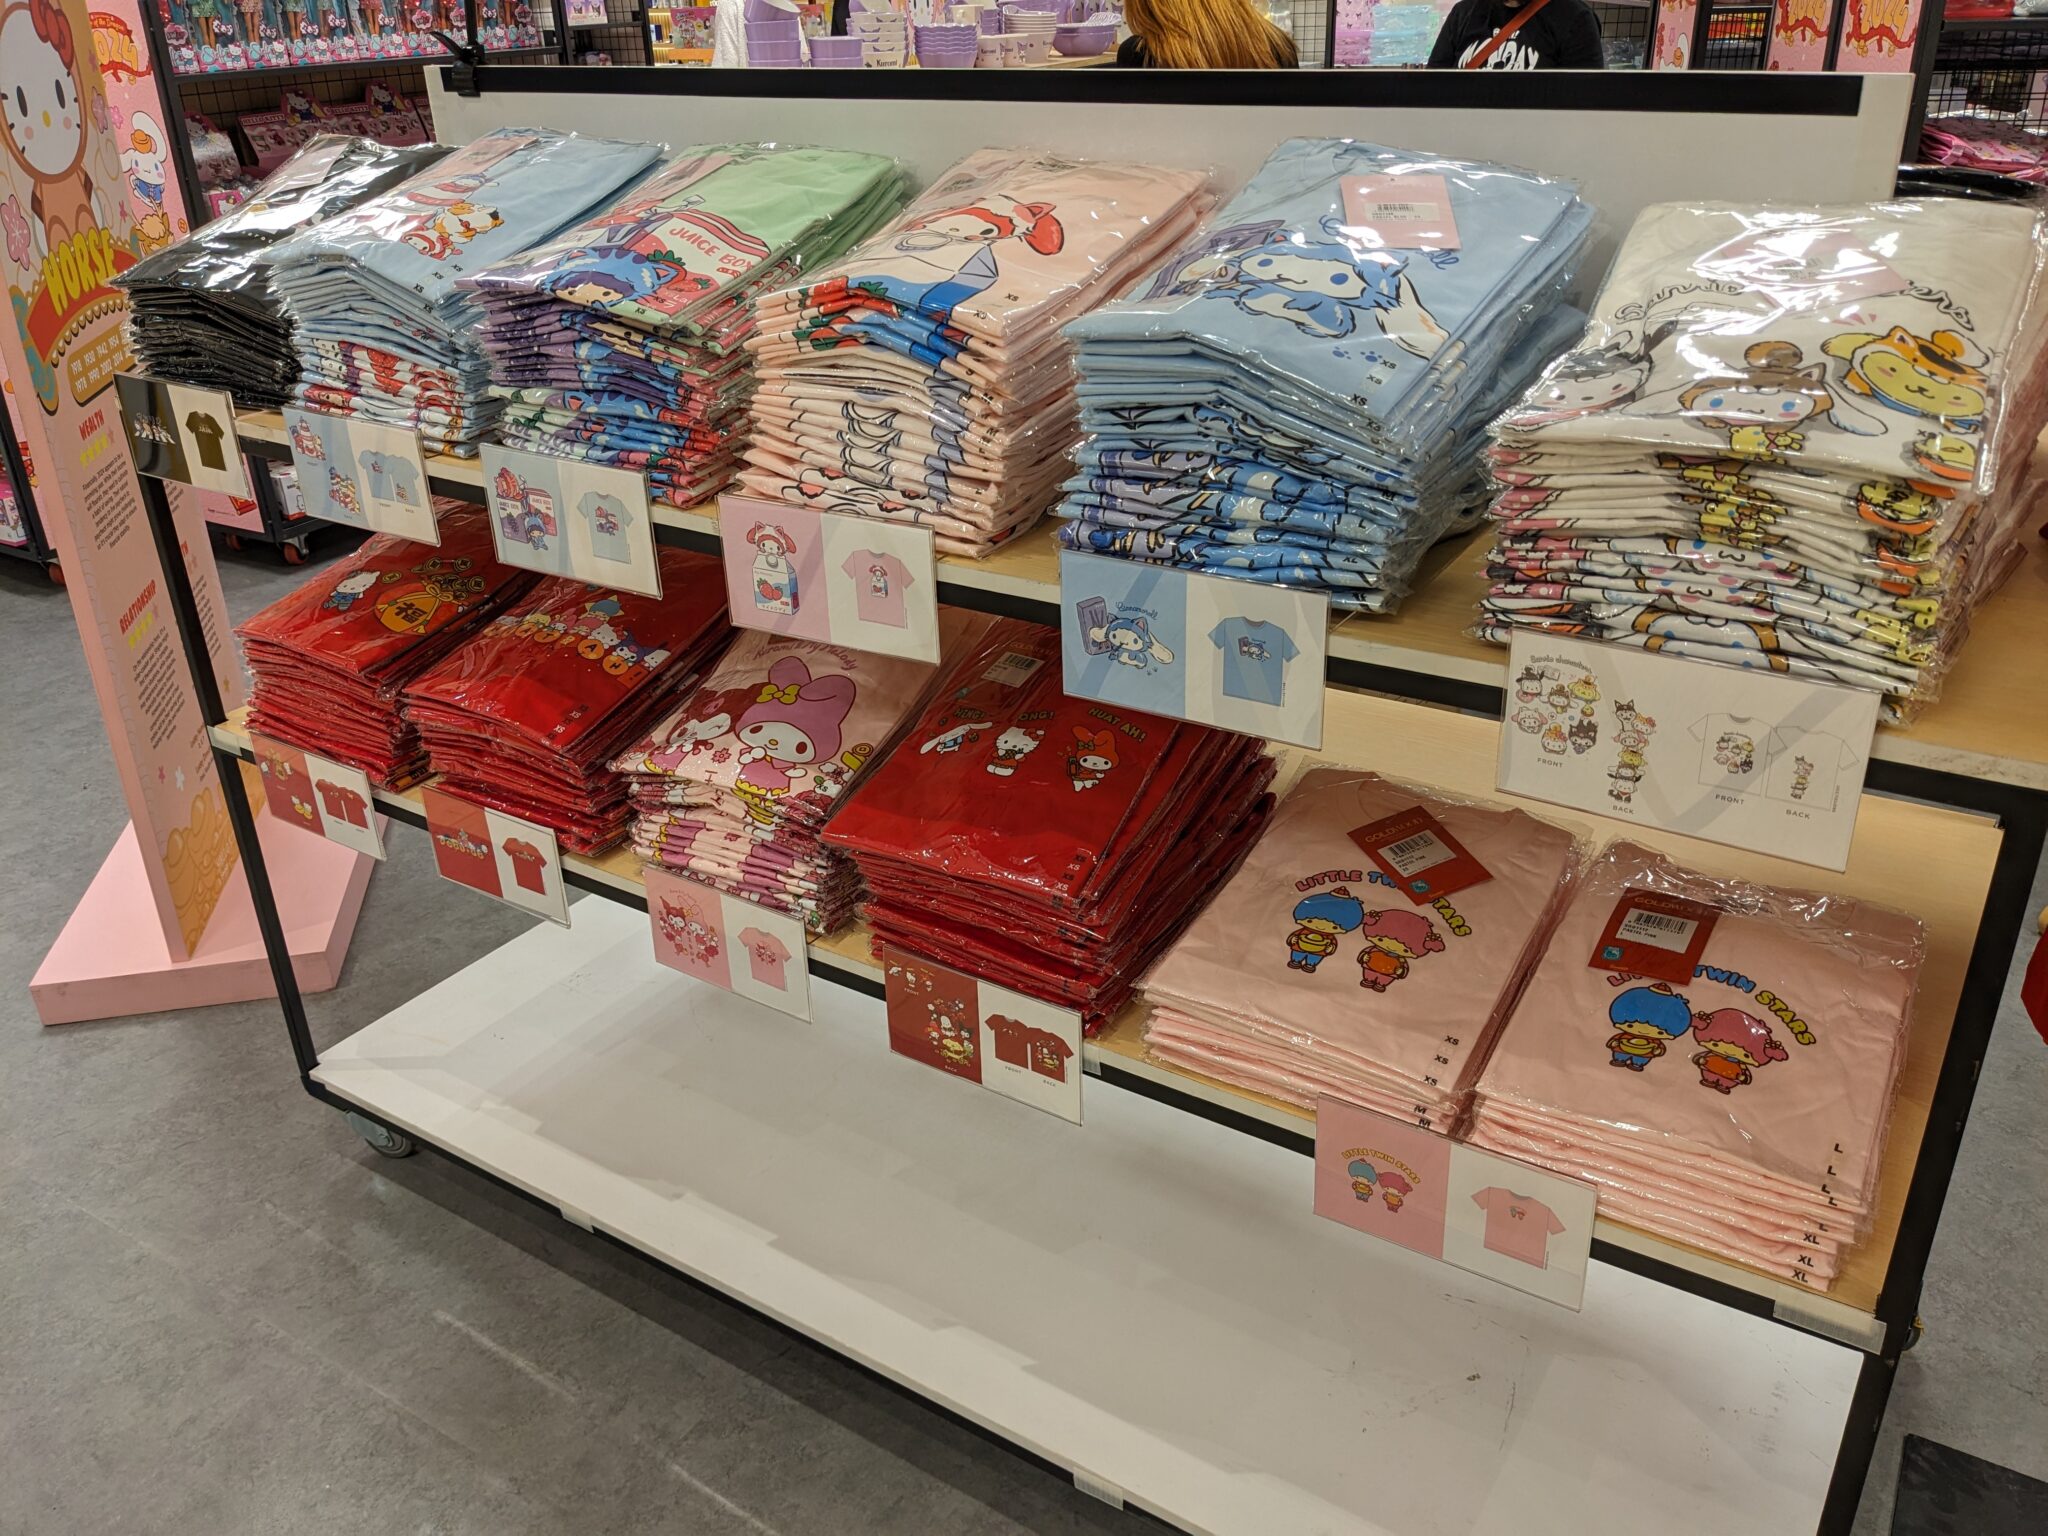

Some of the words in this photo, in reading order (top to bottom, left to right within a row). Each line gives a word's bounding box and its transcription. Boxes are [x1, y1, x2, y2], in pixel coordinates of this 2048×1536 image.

[93, 28, 139, 72] 024
[669, 227, 721, 257] JUICE
[43, 227, 118, 315] HORSE
[1380, 358, 1397, 370] XS
[1366, 373, 1383, 386] XS
[1351, 392, 1368, 407] XS
[79, 408, 105, 441] WEALTH
[119, 579, 156, 635] RELATIONSHIP
[394, 601, 428, 624] 福
[1087, 707, 1121, 724] HUAT
[1119, 721, 1148, 743] AH!
[1536, 756, 1564, 769] FRONT
[1714, 793, 1745, 806] FRONT
[1612, 804, 1635, 816] BACK
[1785, 808, 1811, 821] BACK
[1055, 881, 1069, 891] XS
[1294, 869, 1364, 893] LITTLE
[1366, 870, 1398, 889] TW
[1428, 896, 1473, 937] TARS
[1692, 963, 1757, 994] TWIN
[1754, 989, 1817, 1046] STARS
[1443, 1034, 1460, 1046] XS
[1433, 1053, 1450, 1065] XS
[1423, 1074, 1438, 1087] XS
[1413, 1103, 1428, 1115] M
[1418, 1116, 1432, 1129] M
[1833, 1142, 1844, 1154] L
[1827, 1164, 1837, 1177] L
[1821, 1183, 1831, 1195] L
[1828, 1196, 1838, 1207] L
[1803, 1232, 1820, 1246] XL
[1797, 1253, 1815, 1268] XL
[1791, 1268, 1809, 1284] XL
